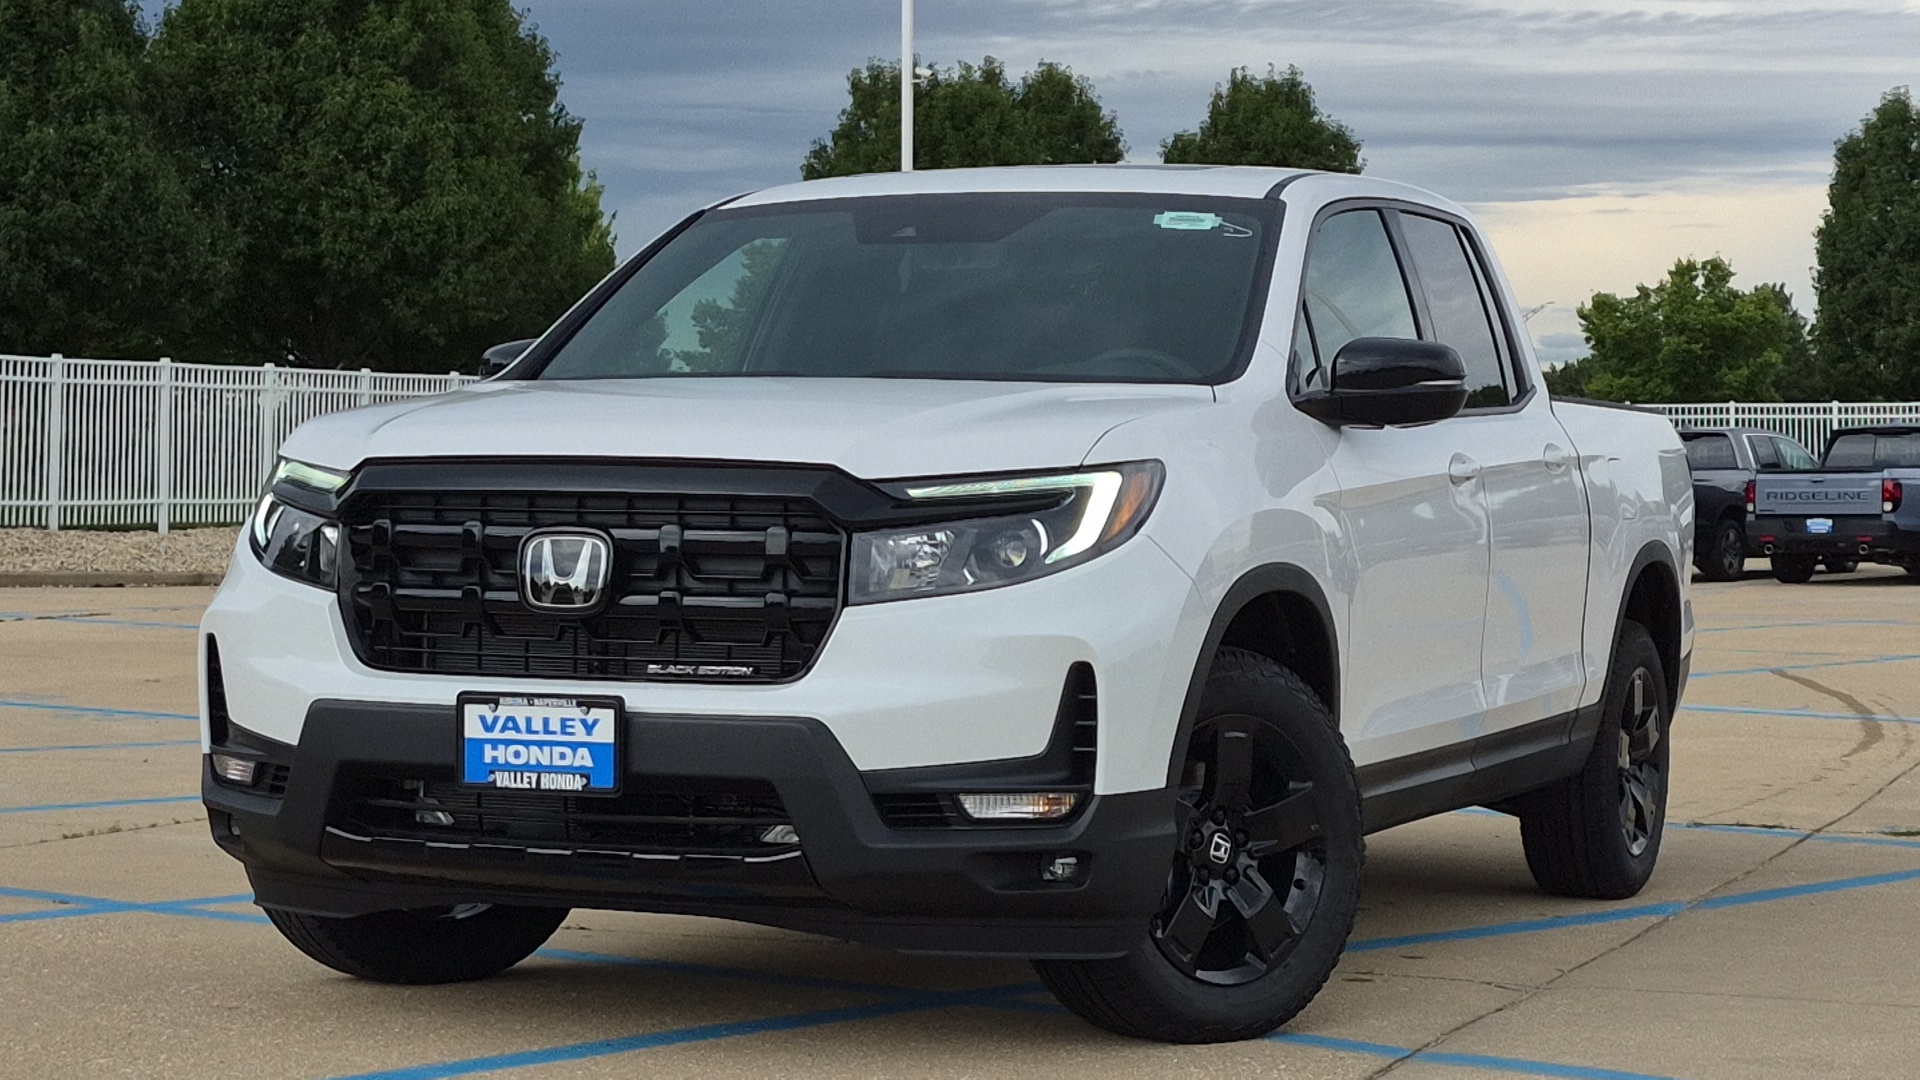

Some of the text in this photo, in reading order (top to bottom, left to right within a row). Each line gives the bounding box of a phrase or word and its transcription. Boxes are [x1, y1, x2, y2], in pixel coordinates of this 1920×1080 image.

[1766, 491, 1869, 501] RIDGELINE
[647, 664, 753, 676] BLACK EDITION
[478, 714, 601, 736] VALLEY
[483, 743, 594, 767] HONDA
[495, 771, 583, 791] VALLEY HONDA
